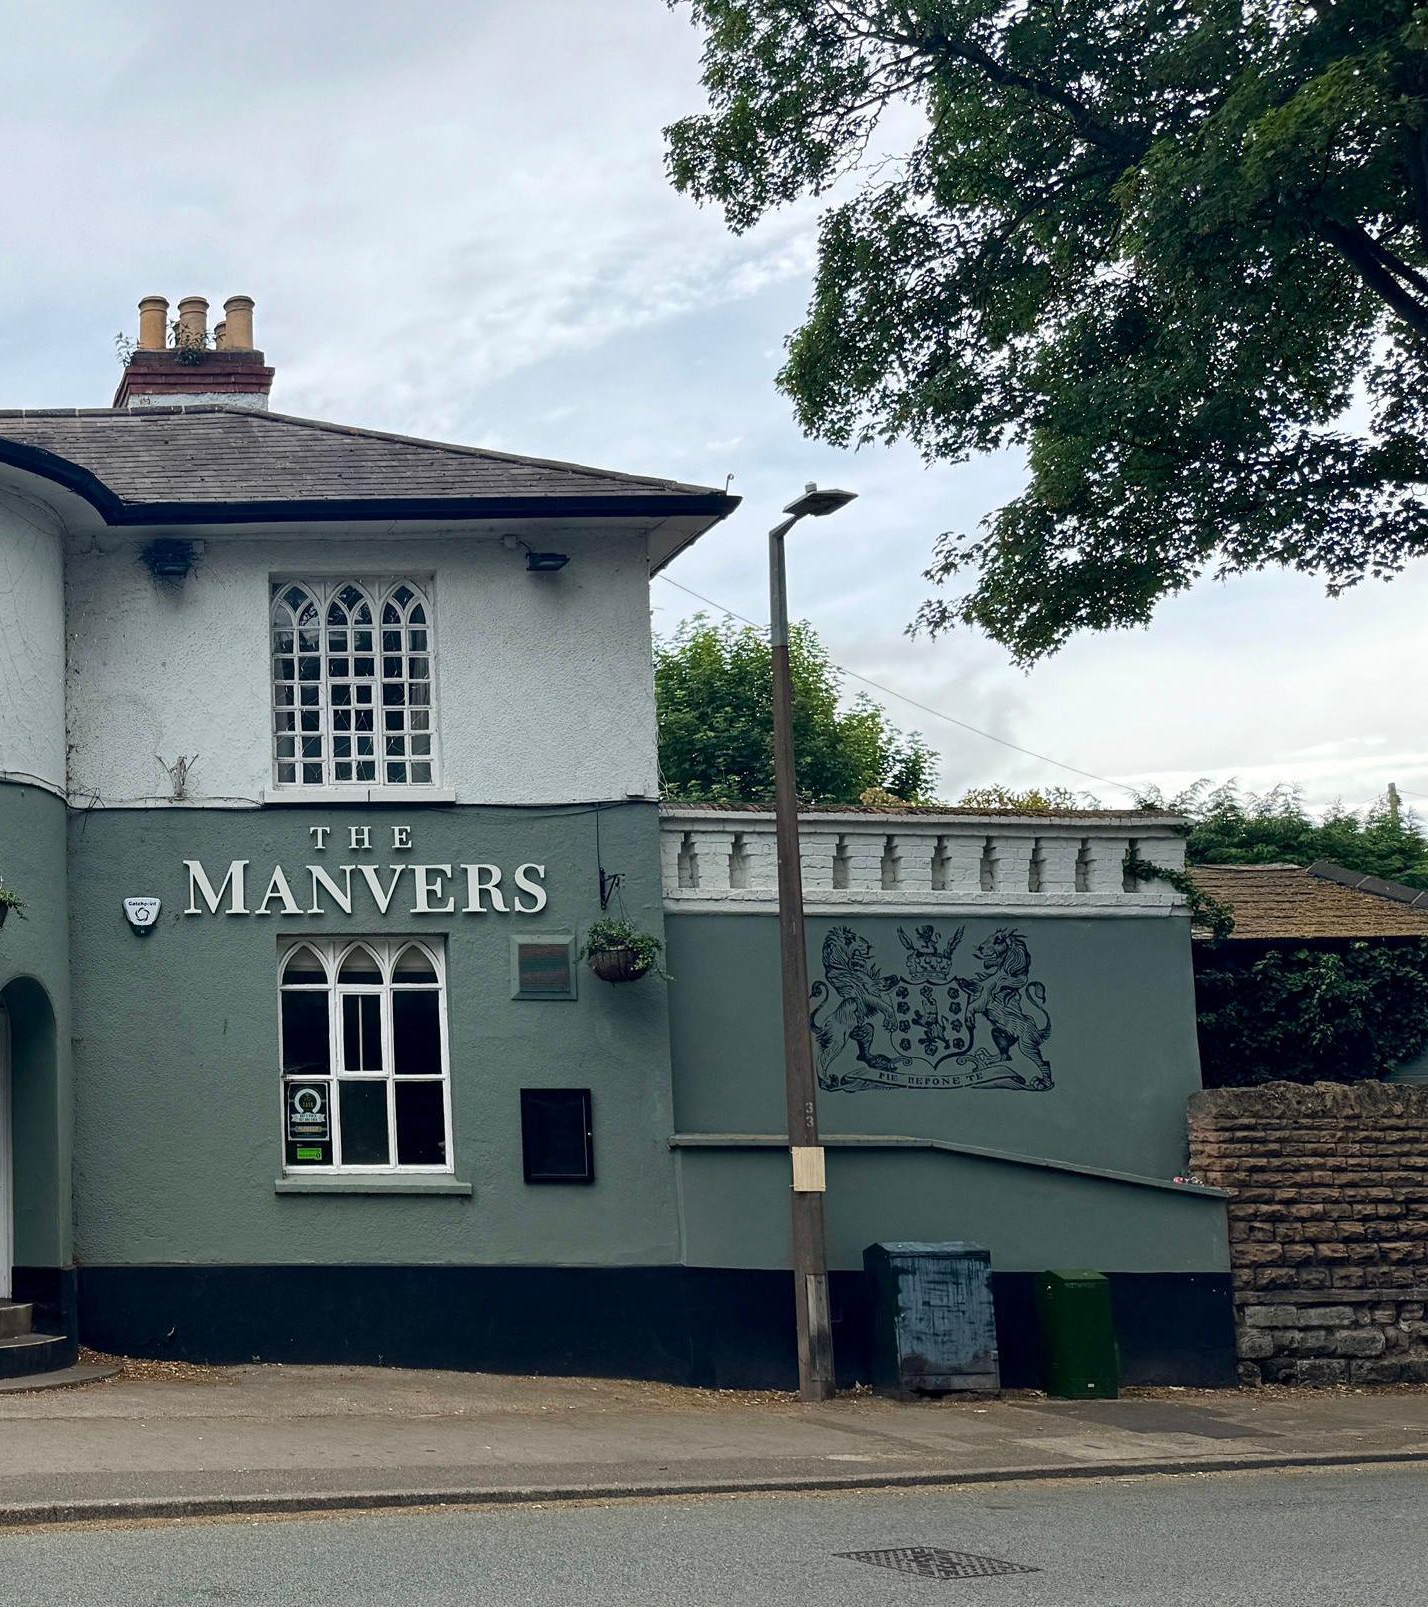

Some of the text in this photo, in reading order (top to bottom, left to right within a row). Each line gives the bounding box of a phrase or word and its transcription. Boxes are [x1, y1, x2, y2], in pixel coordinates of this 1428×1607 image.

[309, 825, 412, 849] THE
[183, 859, 548, 914] MANVERS
[966, 1072, 984, 1081] TE
